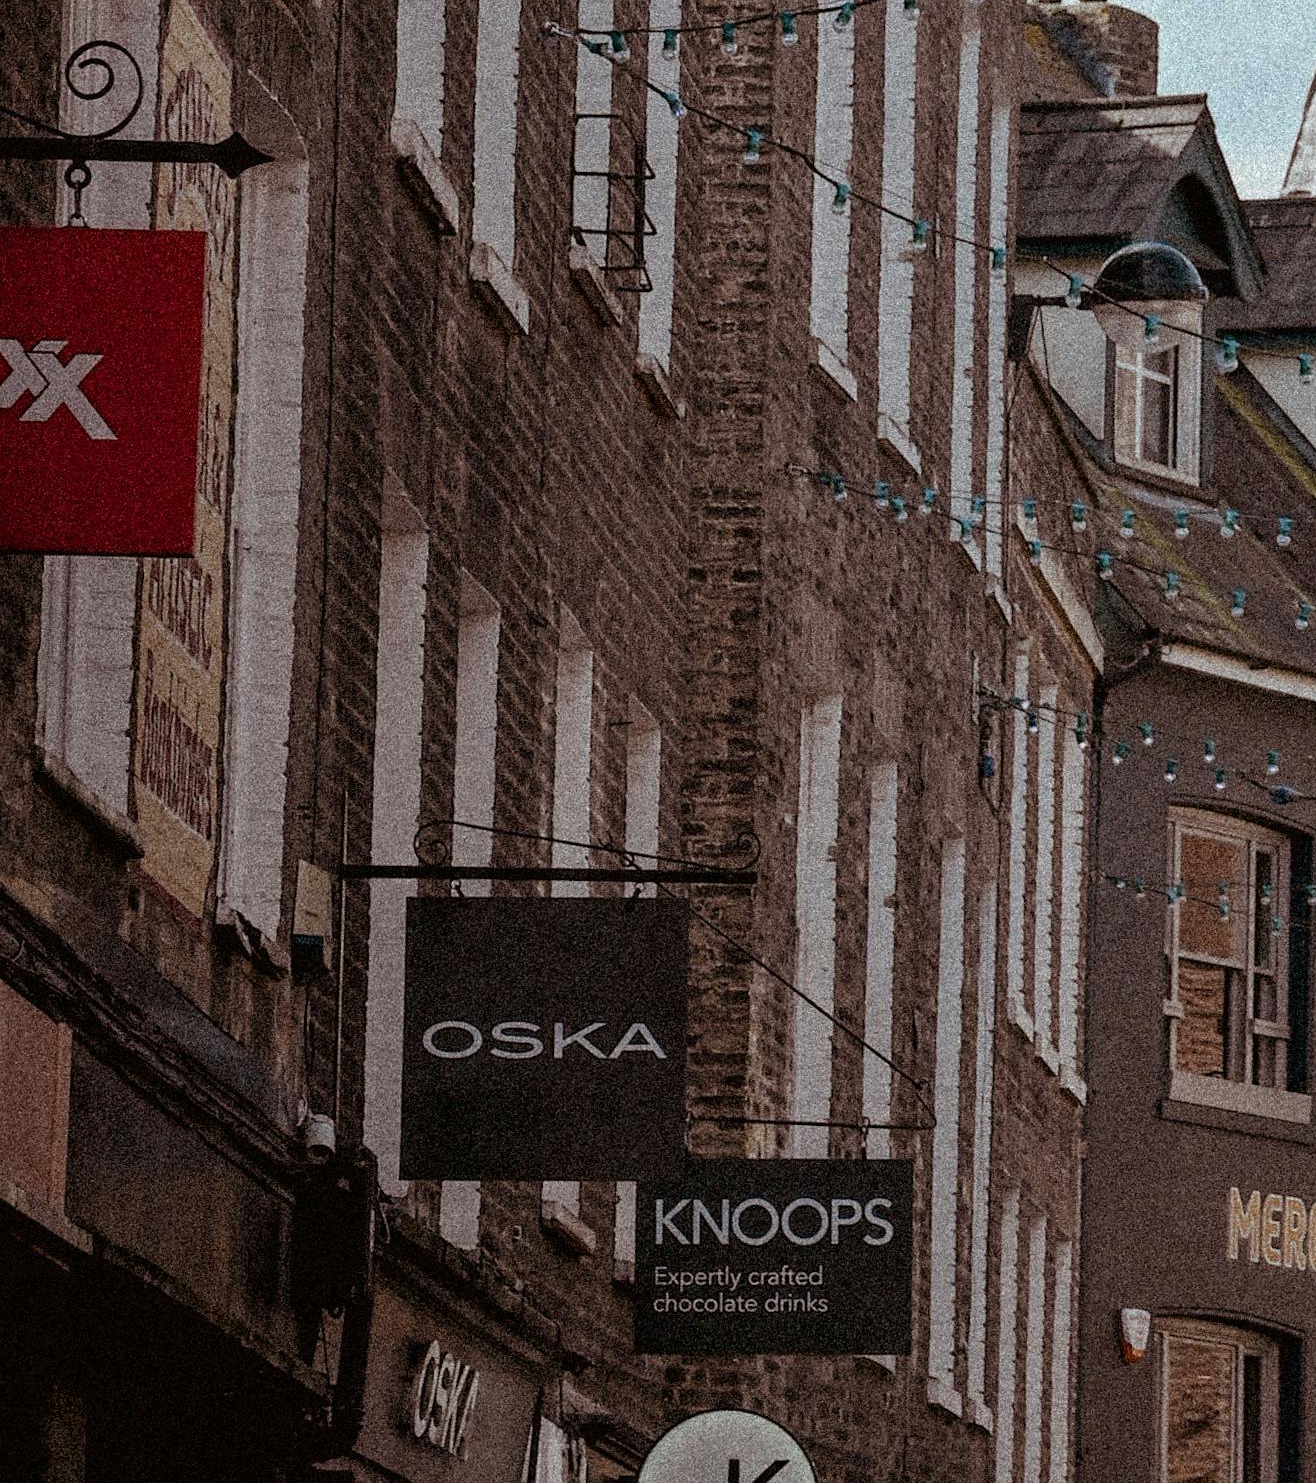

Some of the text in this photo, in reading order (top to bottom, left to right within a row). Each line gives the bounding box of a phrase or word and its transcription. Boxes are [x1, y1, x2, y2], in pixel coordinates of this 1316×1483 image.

[422, 1019, 668, 1060] OSKA
[654, 1196, 895, 1247] KNOOPS
[653, 1265, 824, 1292] Expertly crafted
[652, 1292, 829, 1315] chocolate drinks
[413, 1339, 481, 1460] OSKA
